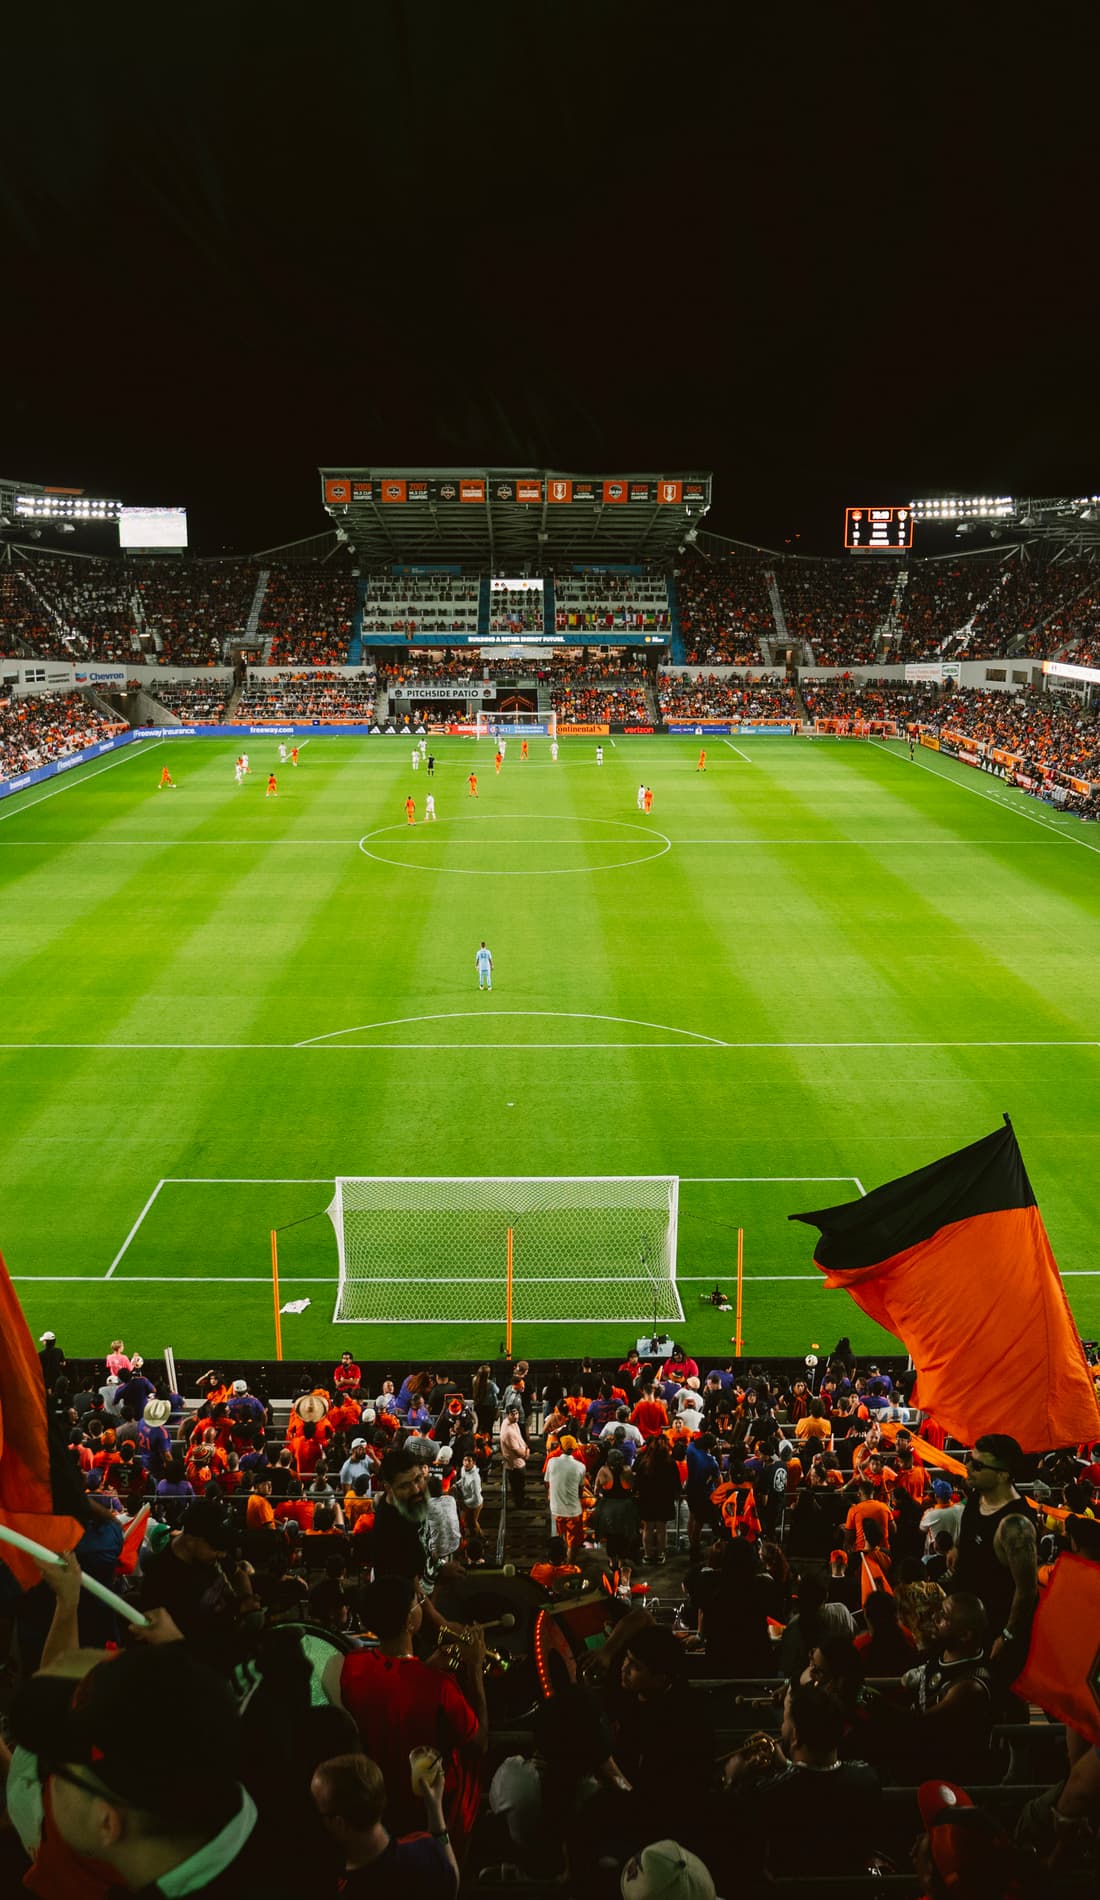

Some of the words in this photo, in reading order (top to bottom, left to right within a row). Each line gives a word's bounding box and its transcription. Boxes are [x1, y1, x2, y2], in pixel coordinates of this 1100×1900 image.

[89, 672, 124, 681] Chevron
[407, 690, 451, 698] PITCHSIDE
[452, 690, 479, 698] PATIO
[250, 726, 294, 735] freeway.com
[138, 1432, 151, 1451] 21
